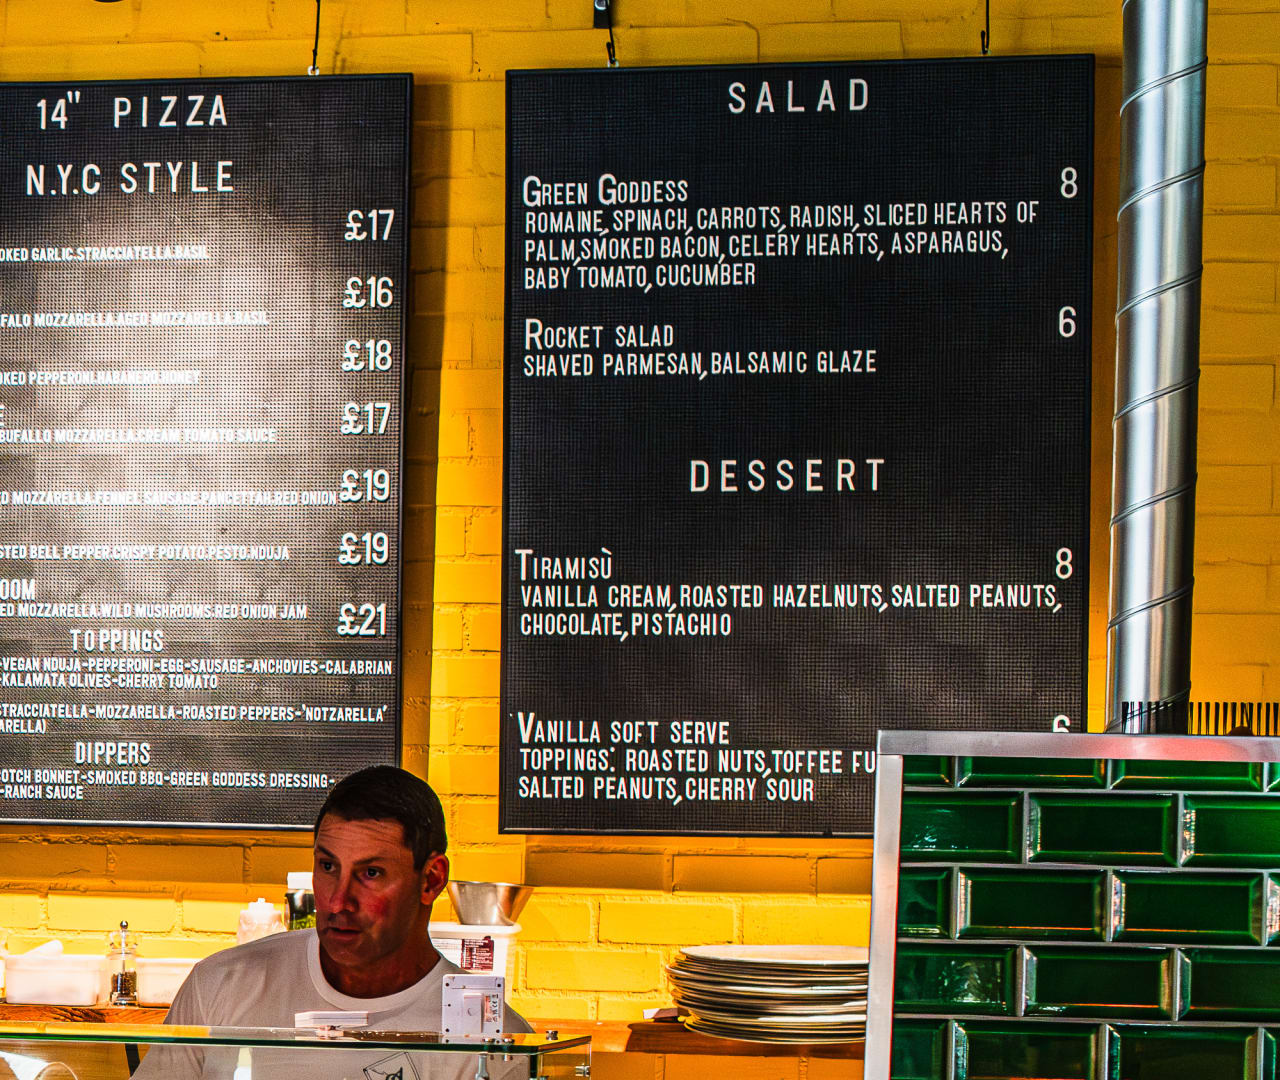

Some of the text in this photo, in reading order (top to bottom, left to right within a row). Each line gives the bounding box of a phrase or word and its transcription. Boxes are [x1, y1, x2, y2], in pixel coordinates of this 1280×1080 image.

[37, 91, 228, 130] 14" PIZZA
[728, 78, 868, 113] SALAD
[27, 162, 234, 196] N.Y.C STYLE
[523, 167, 1078, 207] GREEN GODDESS 8
[344, 209, 394, 241] £17
[934, 201, 1007, 225] HEARTS
[1017, 200, 1039, 223] OF
[343, 276, 394, 308] £16
[525, 266, 570, 290] BABY
[525, 306, 1077, 350] ROCKET SALAD 6
[342, 339, 392, 372] £18
[524, 353, 593, 377] SHAVED
[817, 349, 877, 373] GLAZE
[340, 402, 391, 435] £17
[184, 428, 233, 443] TOMATO
[238, 428, 276, 443] SAUCE
[339, 469, 391, 502] £19
[690, 458, 885, 492] DESSERT
[301, 491, 337, 505] ONION
[30, 545, 61, 560] BELL
[338, 532, 389, 565] £19
[1055, 547, 1073, 580] 8
[521, 585, 598, 608] VANILLA
[241, 605, 277, 619] ONION
[280, 605, 308, 619] JAM
[337, 603, 386, 636] £21
[70, 629, 164, 652] TOPPINGS
[168, 675, 218, 689] TOMATO
[518, 711, 601, 744] VANILLA
[610, 720, 659, 744] SOFT
[670, 720, 730, 745] SERVE
[75, 741, 151, 765] DIPPERS
[519, 748, 615, 773] TOPPINGS:
[626, 748, 709, 773] ROASTED
[46, 785, 83, 799] SAUCE
[213, 773, 266, 787] GODDESS
[519, 775, 584, 799] SALTED
[766, 777, 814, 802] SOUR
